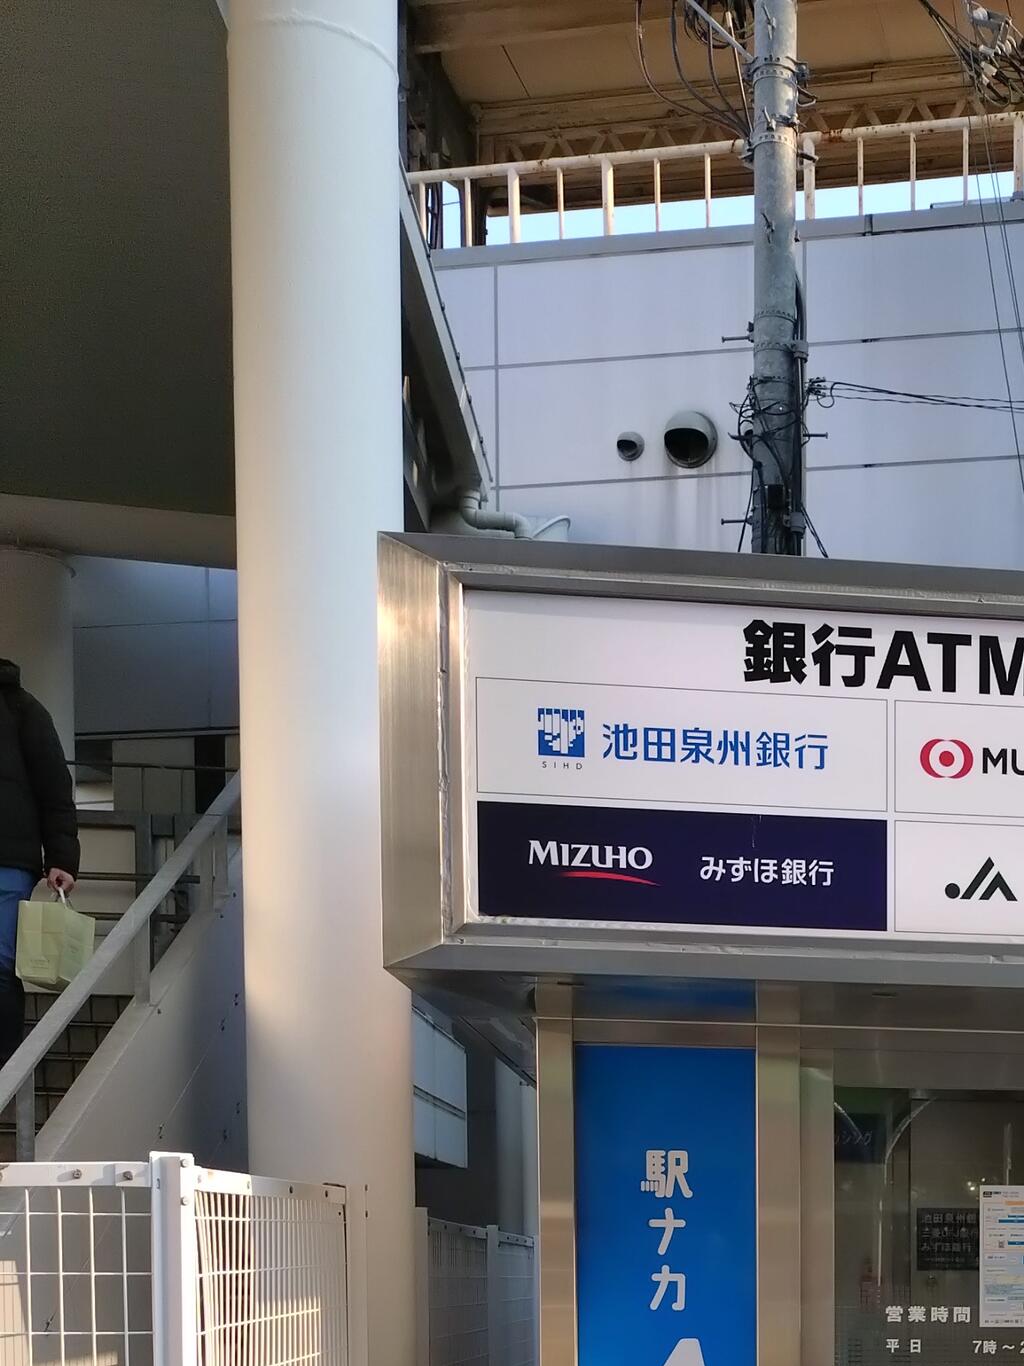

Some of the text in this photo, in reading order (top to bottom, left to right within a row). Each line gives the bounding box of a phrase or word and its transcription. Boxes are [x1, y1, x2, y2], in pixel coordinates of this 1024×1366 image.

[602, 723, 828, 770] 池田泉州銀行
[528, 840, 653, 870] MIZUHO
[700, 856, 834, 886] みずほ銀行
[640, 1149, 693, 1311] 駅ナカ
[885, 1306, 971, 1323] 営業時間
